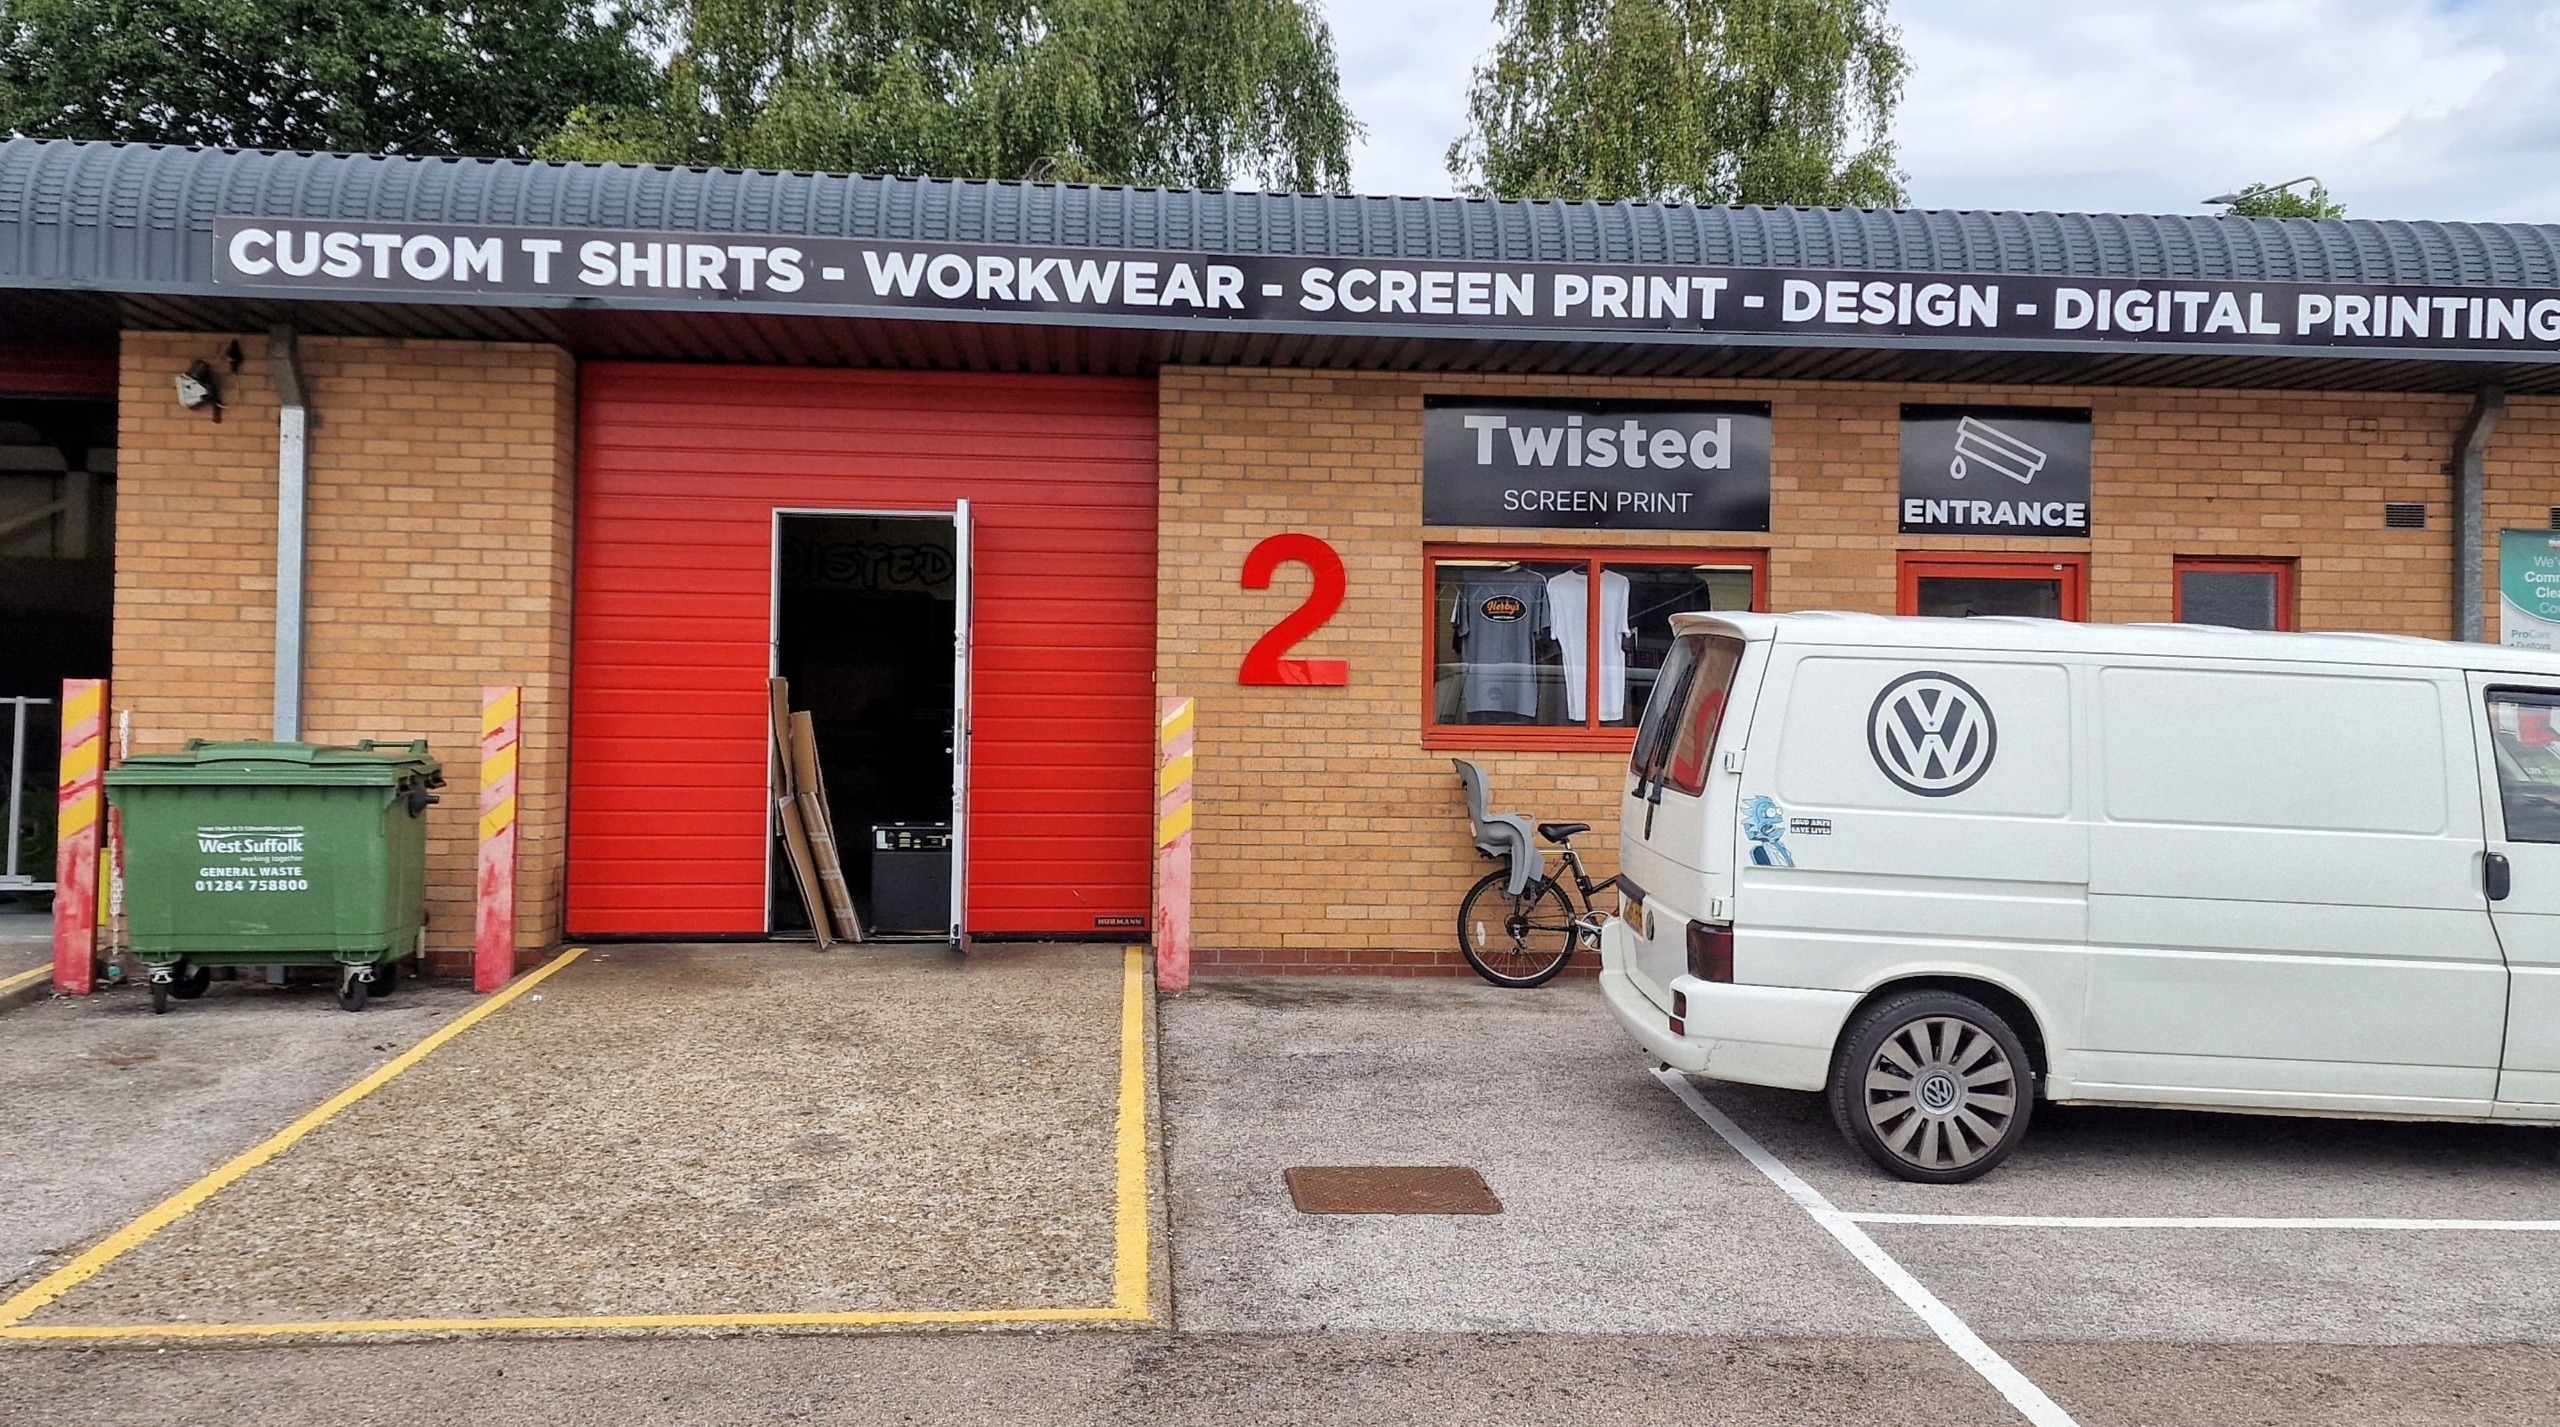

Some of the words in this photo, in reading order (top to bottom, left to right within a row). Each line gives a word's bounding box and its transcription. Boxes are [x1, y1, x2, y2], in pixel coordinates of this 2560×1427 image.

[229, 229, 502, 282] CUSTOM
[522, 239, 562, 283] T
[579, 241, 804, 292] SHIRTS
[862, 251, 1244, 308] WORKWEAR
[1300, 268, 1534, 315] SCREEN
[1554, 275, 1727, 319] PRINT
[1783, 280, 1998, 327] DESIGN
[2055, 288, 2280, 334] DIGITAL
[2298, 294, 2560, 340] PRINTING
[1465, 416, 1730, 469] Twisted
[1503, 489, 1608, 512] SCREEN
[1616, 491, 1693, 514] PRINT
[1905, 499, 2085, 526] ENTRANCE
[1238, 533, 1347, 685] 2
[198, 839, 243, 853] West
[244, 838, 304, 853] Suffolk
[200, 867, 256, 877] GENERAL
[259, 866, 303, 876] WASTE
[195, 880, 243, 891] 01284
[249, 879, 308, 891] 758800
